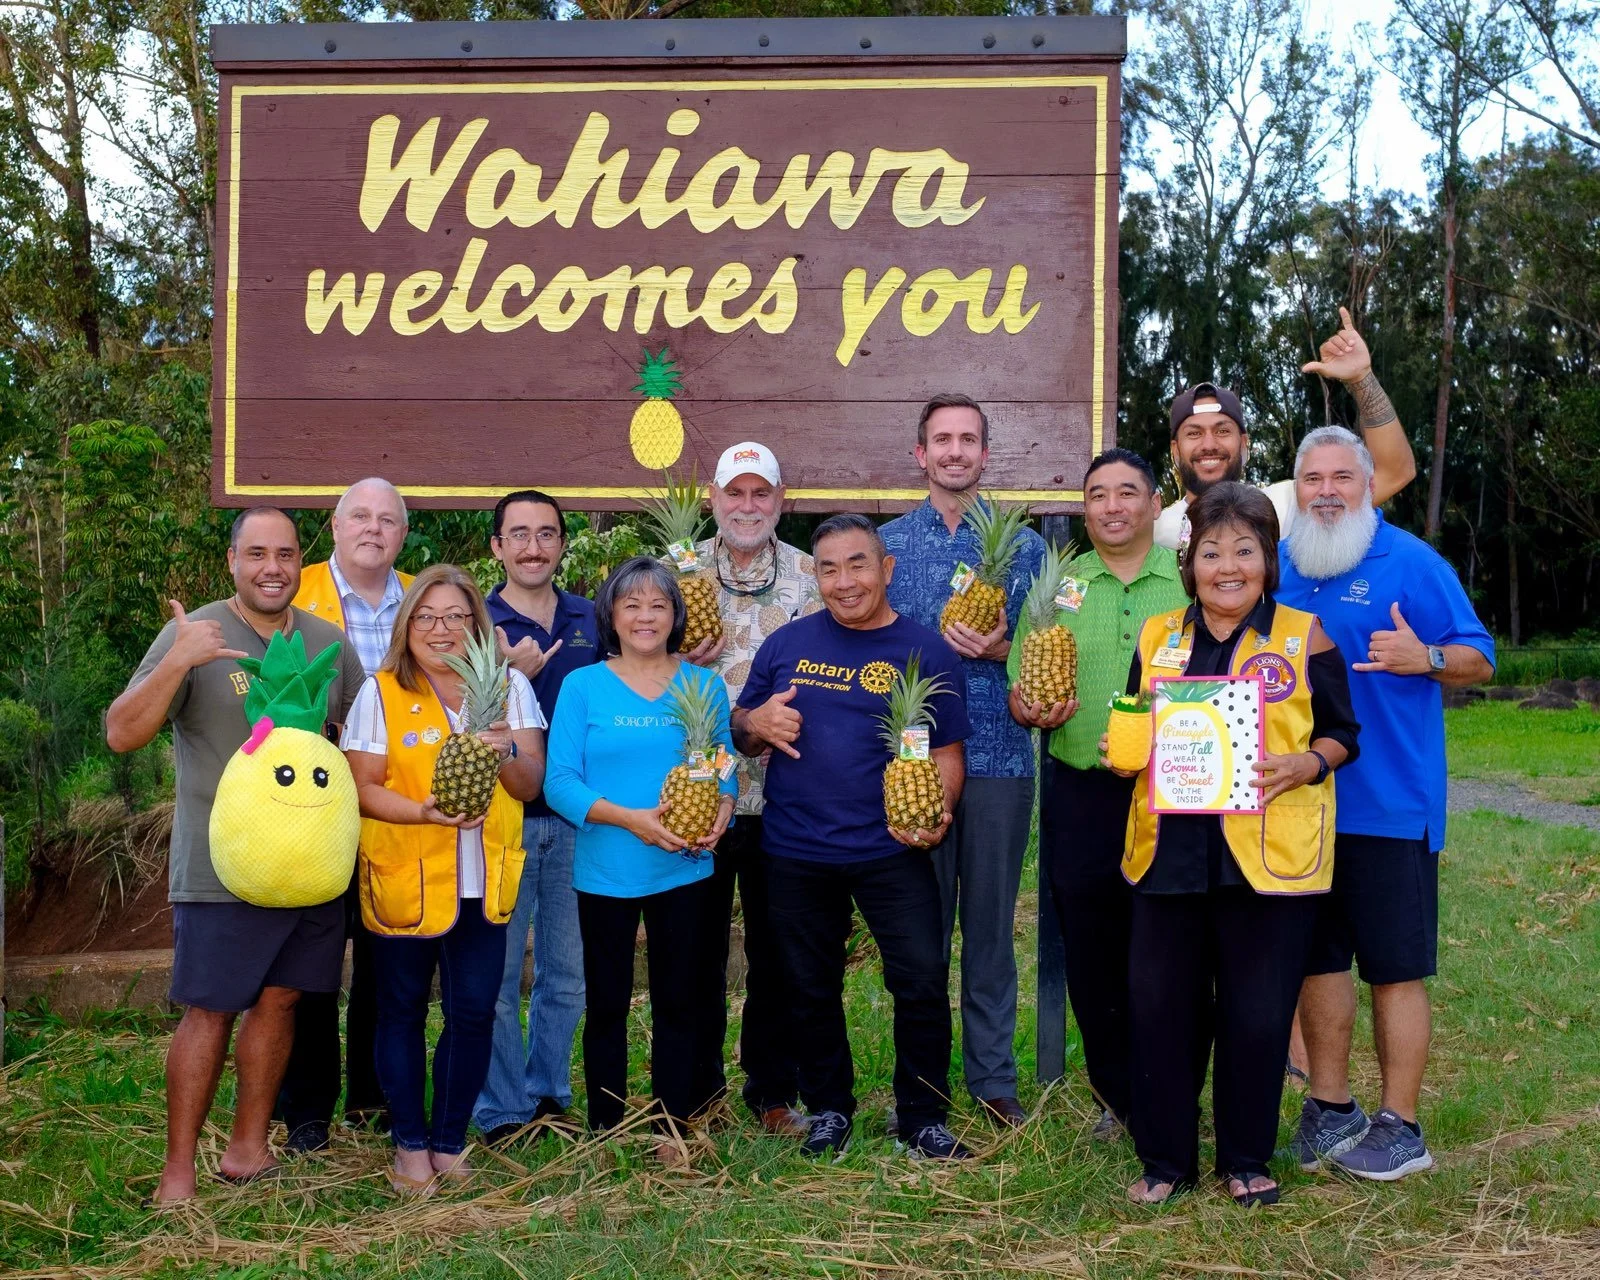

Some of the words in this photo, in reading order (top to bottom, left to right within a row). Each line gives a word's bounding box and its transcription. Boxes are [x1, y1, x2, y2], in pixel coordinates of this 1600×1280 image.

[358, 108, 987, 234] Wahiawa
[305, 237, 798, 336] welcomes
[835, 263, 1042, 368] you
[1255, 657, 1282, 667] LIONS
[795, 659, 857, 682] Rotary
[1261, 667, 1276, 684] L
[789, 678, 817, 686] PEOPLE
[821, 682, 852, 692] ACTION
[614, 715, 684, 727] SOROPTIM
[1179, 719, 1190, 728] BE
[1162, 724, 1215, 741] Pineapple
[1161, 743, 1189, 752] STAND
[1189, 741, 1214, 756] Tall
[1161, 759, 1199, 774] Crown
[1200, 765, 1207, 774] &
[1173, 755, 1197, 763] WEAR
[1199, 755, 1206, 763] A
[1166, 776, 1176, 784] BE
[1178, 772, 1215, 787] Sweet
[1171, 787, 1184, 795] ON
[1186, 787, 1203, 795] THE
[1176, 795, 1205, 804] INSIDE
